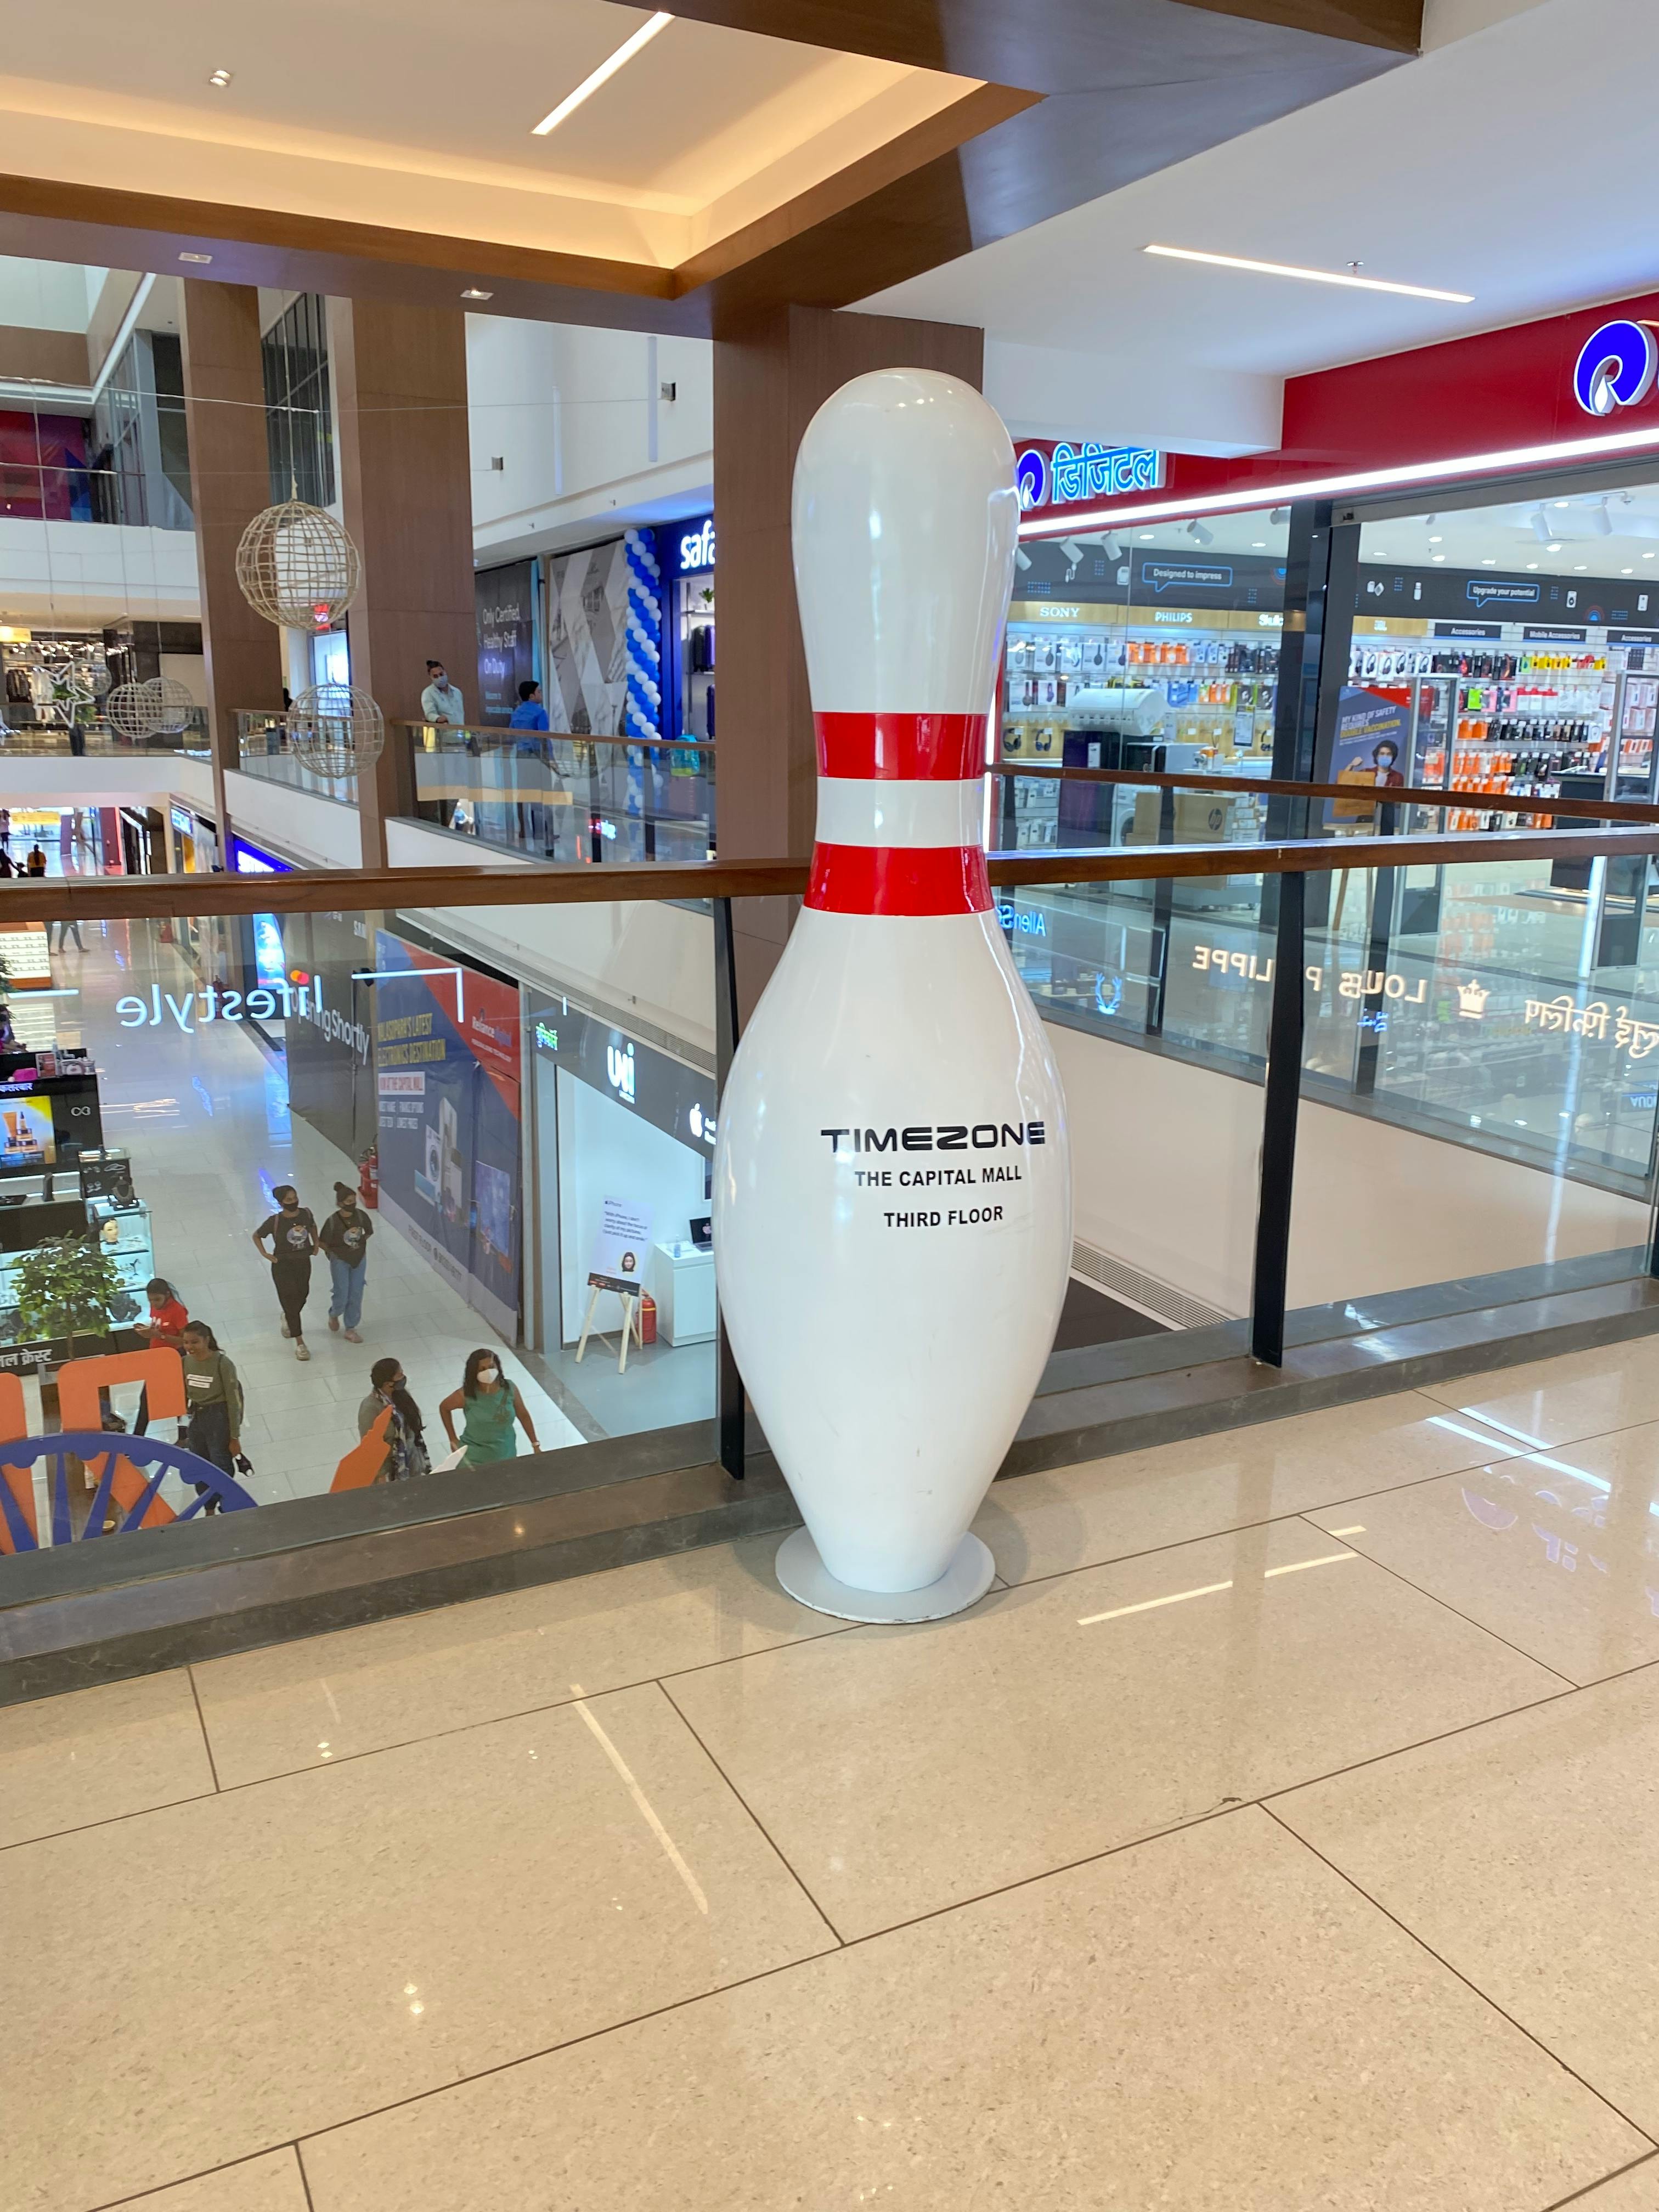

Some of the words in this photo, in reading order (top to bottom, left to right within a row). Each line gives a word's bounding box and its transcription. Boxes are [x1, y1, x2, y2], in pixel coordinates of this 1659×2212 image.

[1051, 443, 1159, 504] डिजिटल
[1153, 568, 1186, 579] Designed
[1195, 571, 1222, 580] impress
[1473, 586, 1497, 595] Upgrade
[1497, 589, 1509, 597] your
[1510, 588, 1535, 597] potential
[1040, 607, 1080, 618] SONY
[1155, 612, 1193, 623] PHILIPS
[1451, 627, 1486, 636] Accessories
[1529, 630, 1547, 639] Mobile
[1547, 631, 1581, 640] Accessories
[1621, 634, 1652, 643] Accessories
[331, 1009, 370, 1066] Shortly
[821, 1121, 1046, 1153] TIMEZONE
[855, 1171, 892, 1187] THE
[899, 1169, 976, 1187] CAPITAL
[983, 1165, 1023, 1183] MALL
[884, 1211, 940, 1227] THIRD
[948, 1206, 1003, 1225] FLOOR
